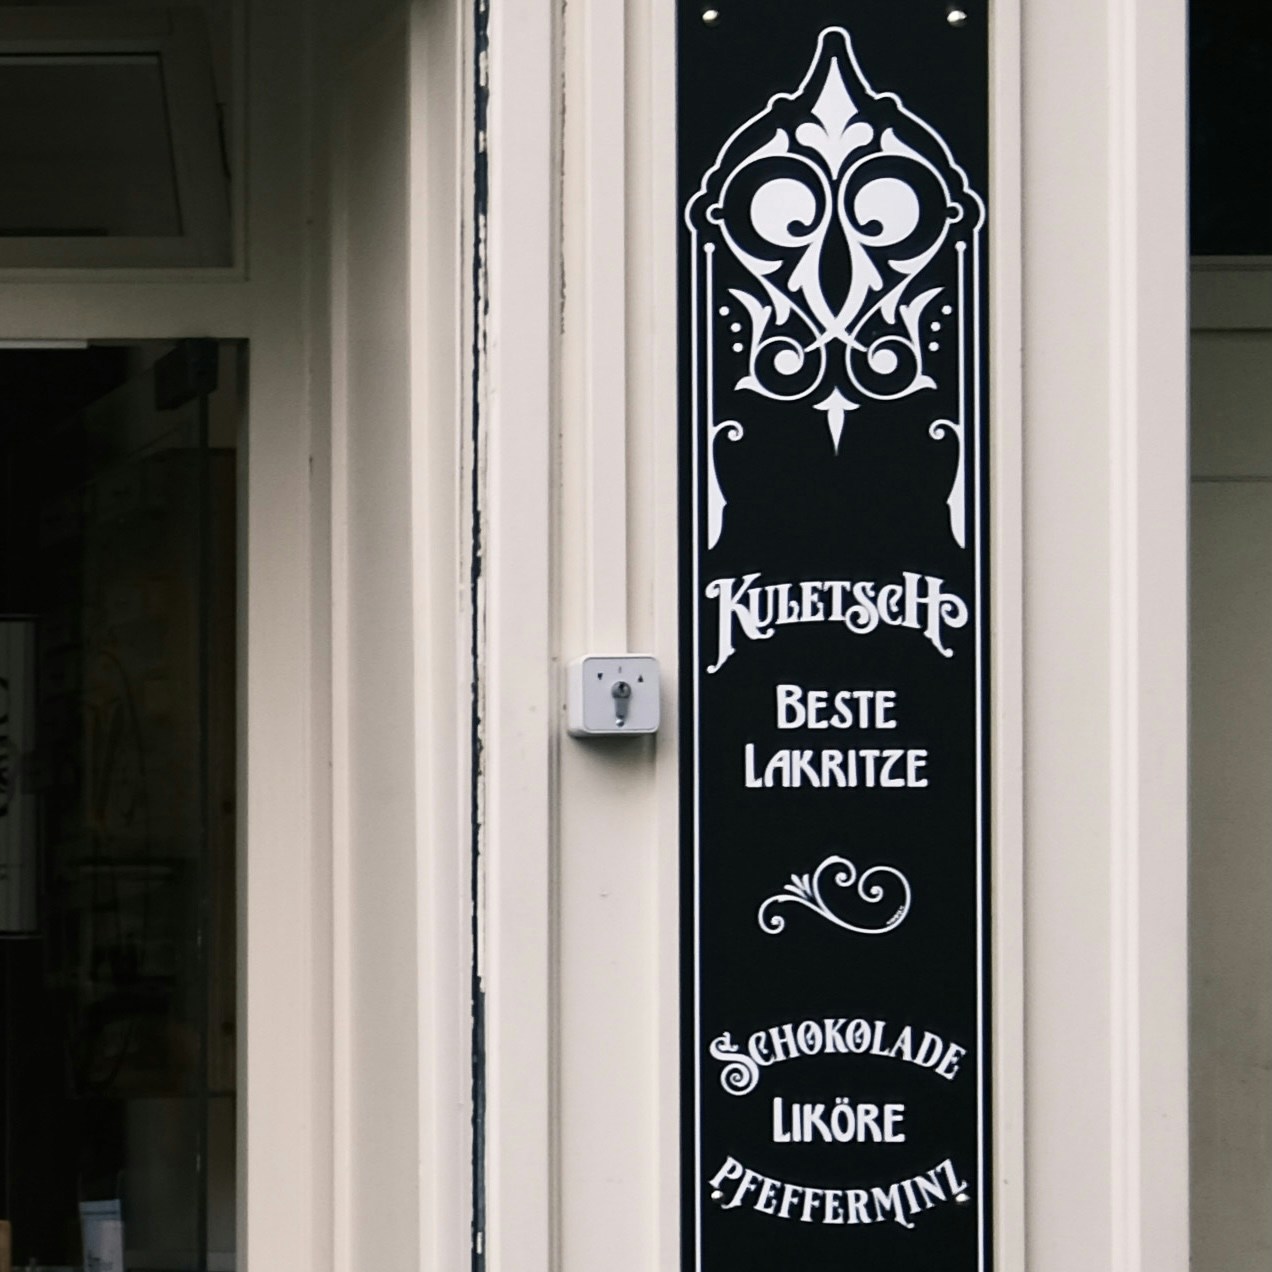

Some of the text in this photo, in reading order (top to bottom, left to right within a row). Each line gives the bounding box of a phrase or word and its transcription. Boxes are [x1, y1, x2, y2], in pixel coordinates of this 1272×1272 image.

[705, 571, 968, 674] KULETSCH
[777, 685, 896, 728] BESTE
[745, 744, 928, 787] LAKRITZE
[709, 1018, 967, 1096] SCHOKOLADE
[773, 1097, 906, 1143] LIKÖRE
[708, 1155, 969, 1229] PFEFFERMINZ
